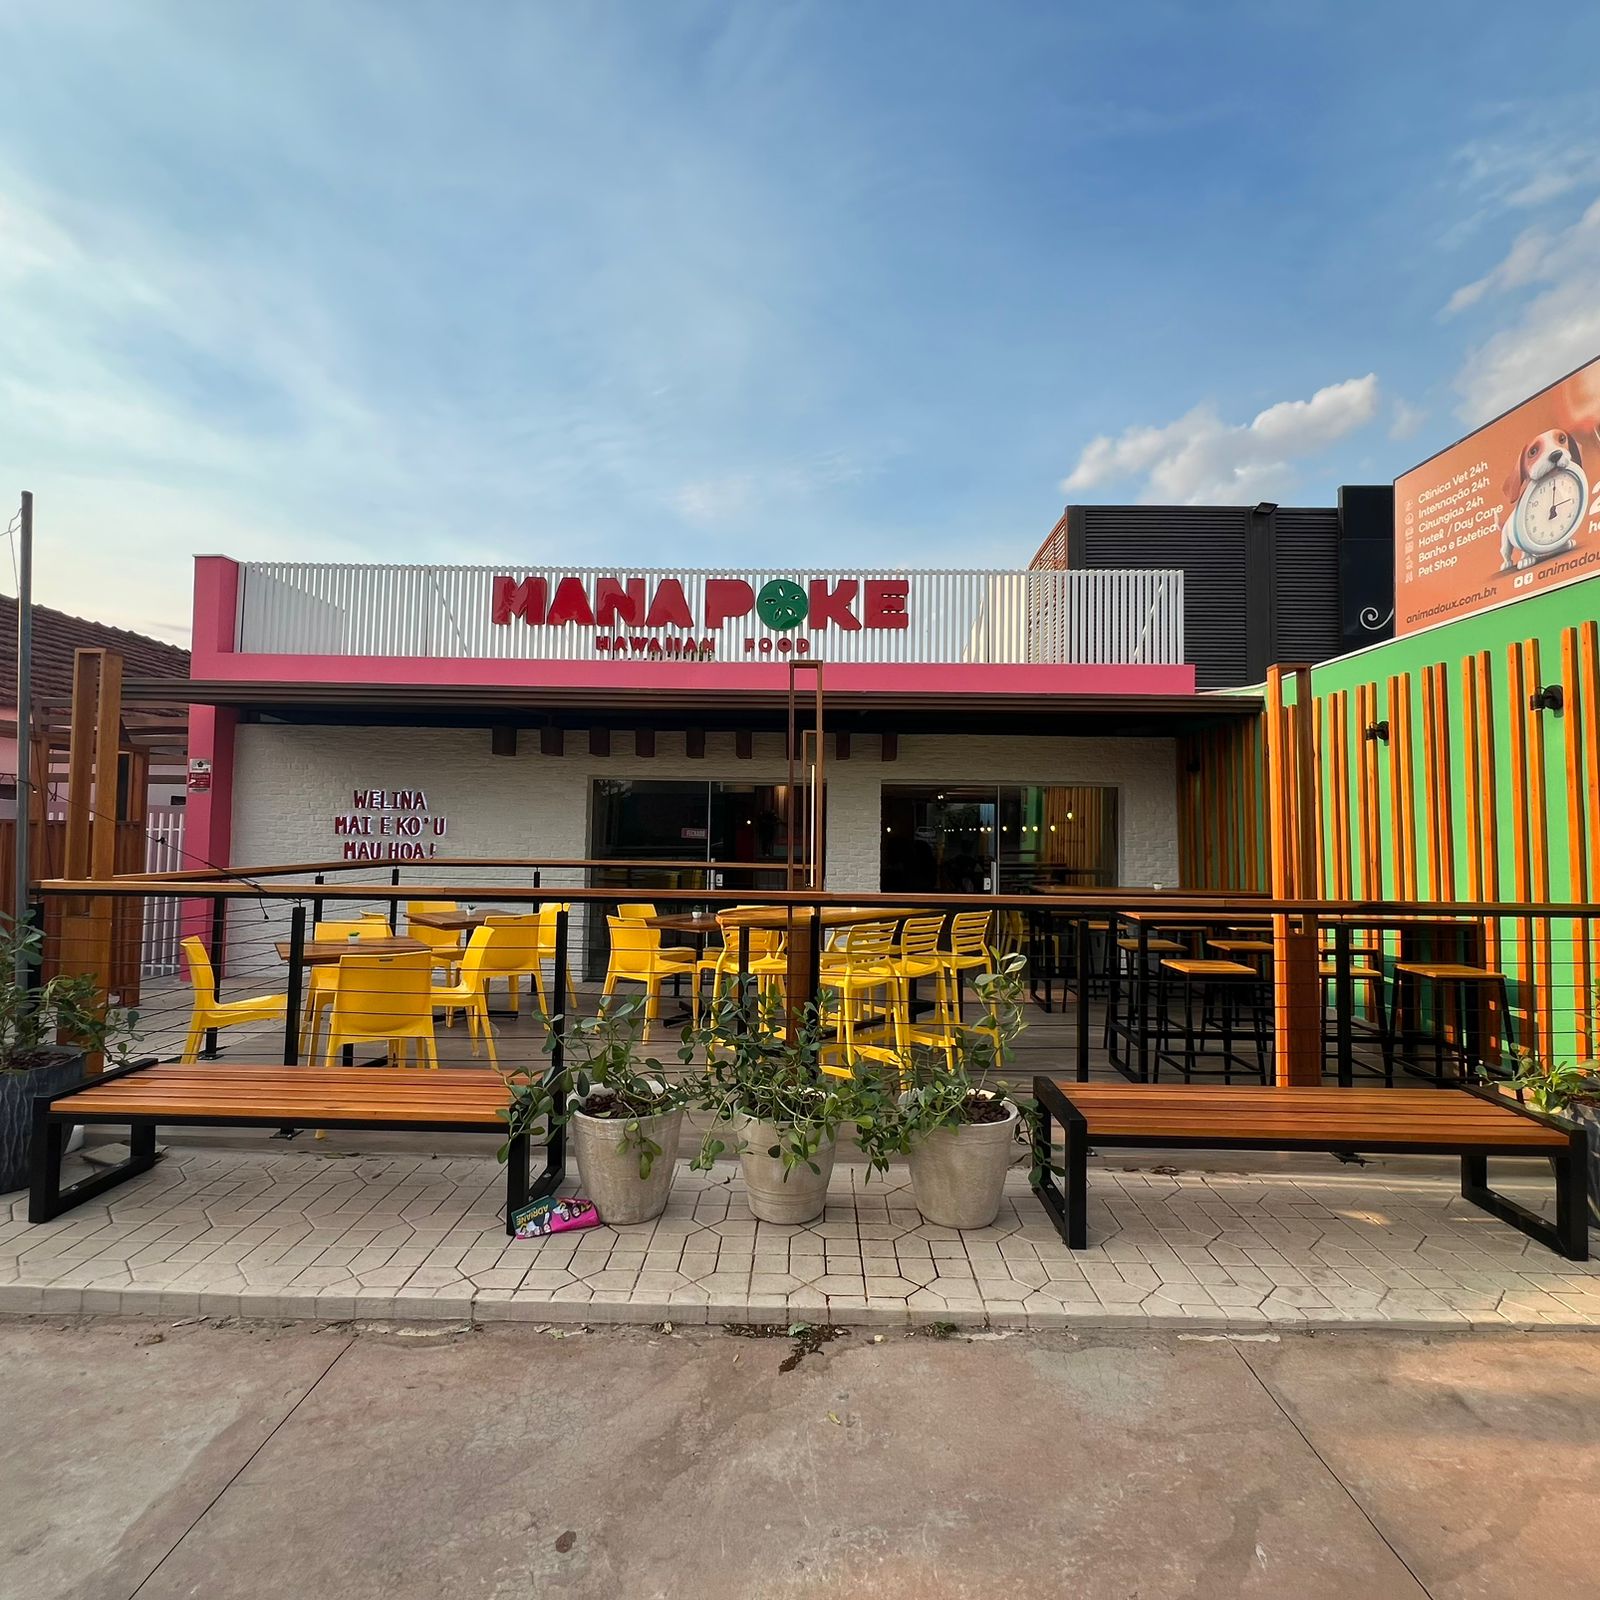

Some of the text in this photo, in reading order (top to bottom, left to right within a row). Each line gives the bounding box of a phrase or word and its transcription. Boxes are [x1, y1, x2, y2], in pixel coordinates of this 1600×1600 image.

[1452, 471, 1468, 486] Vet
[1470, 461, 1488, 477] 24h
[1418, 476, 1490, 518] Internação 24h
[1418, 496, 1484, 532] Cirurgias 24h
[1418, 528, 1444, 548] Hotel
[1454, 517, 1473, 532] Day
[1475, 504, 1504, 522] Care
[1418, 546, 1447, 562] Banho
[1448, 541, 1455, 550] e
[1418, 555, 1458, 577] Pet Shop
[492, 576, 910, 631] MANA POKE
[1406, 587, 1497, 624] animadoux.com.br
[595, 635, 810, 654] HAWAIIAN FOOD
[353, 789, 428, 811] WELINA
[335, 815, 372, 836] MAI
[380, 816, 392, 836] E
[344, 841, 382, 860] MAU
